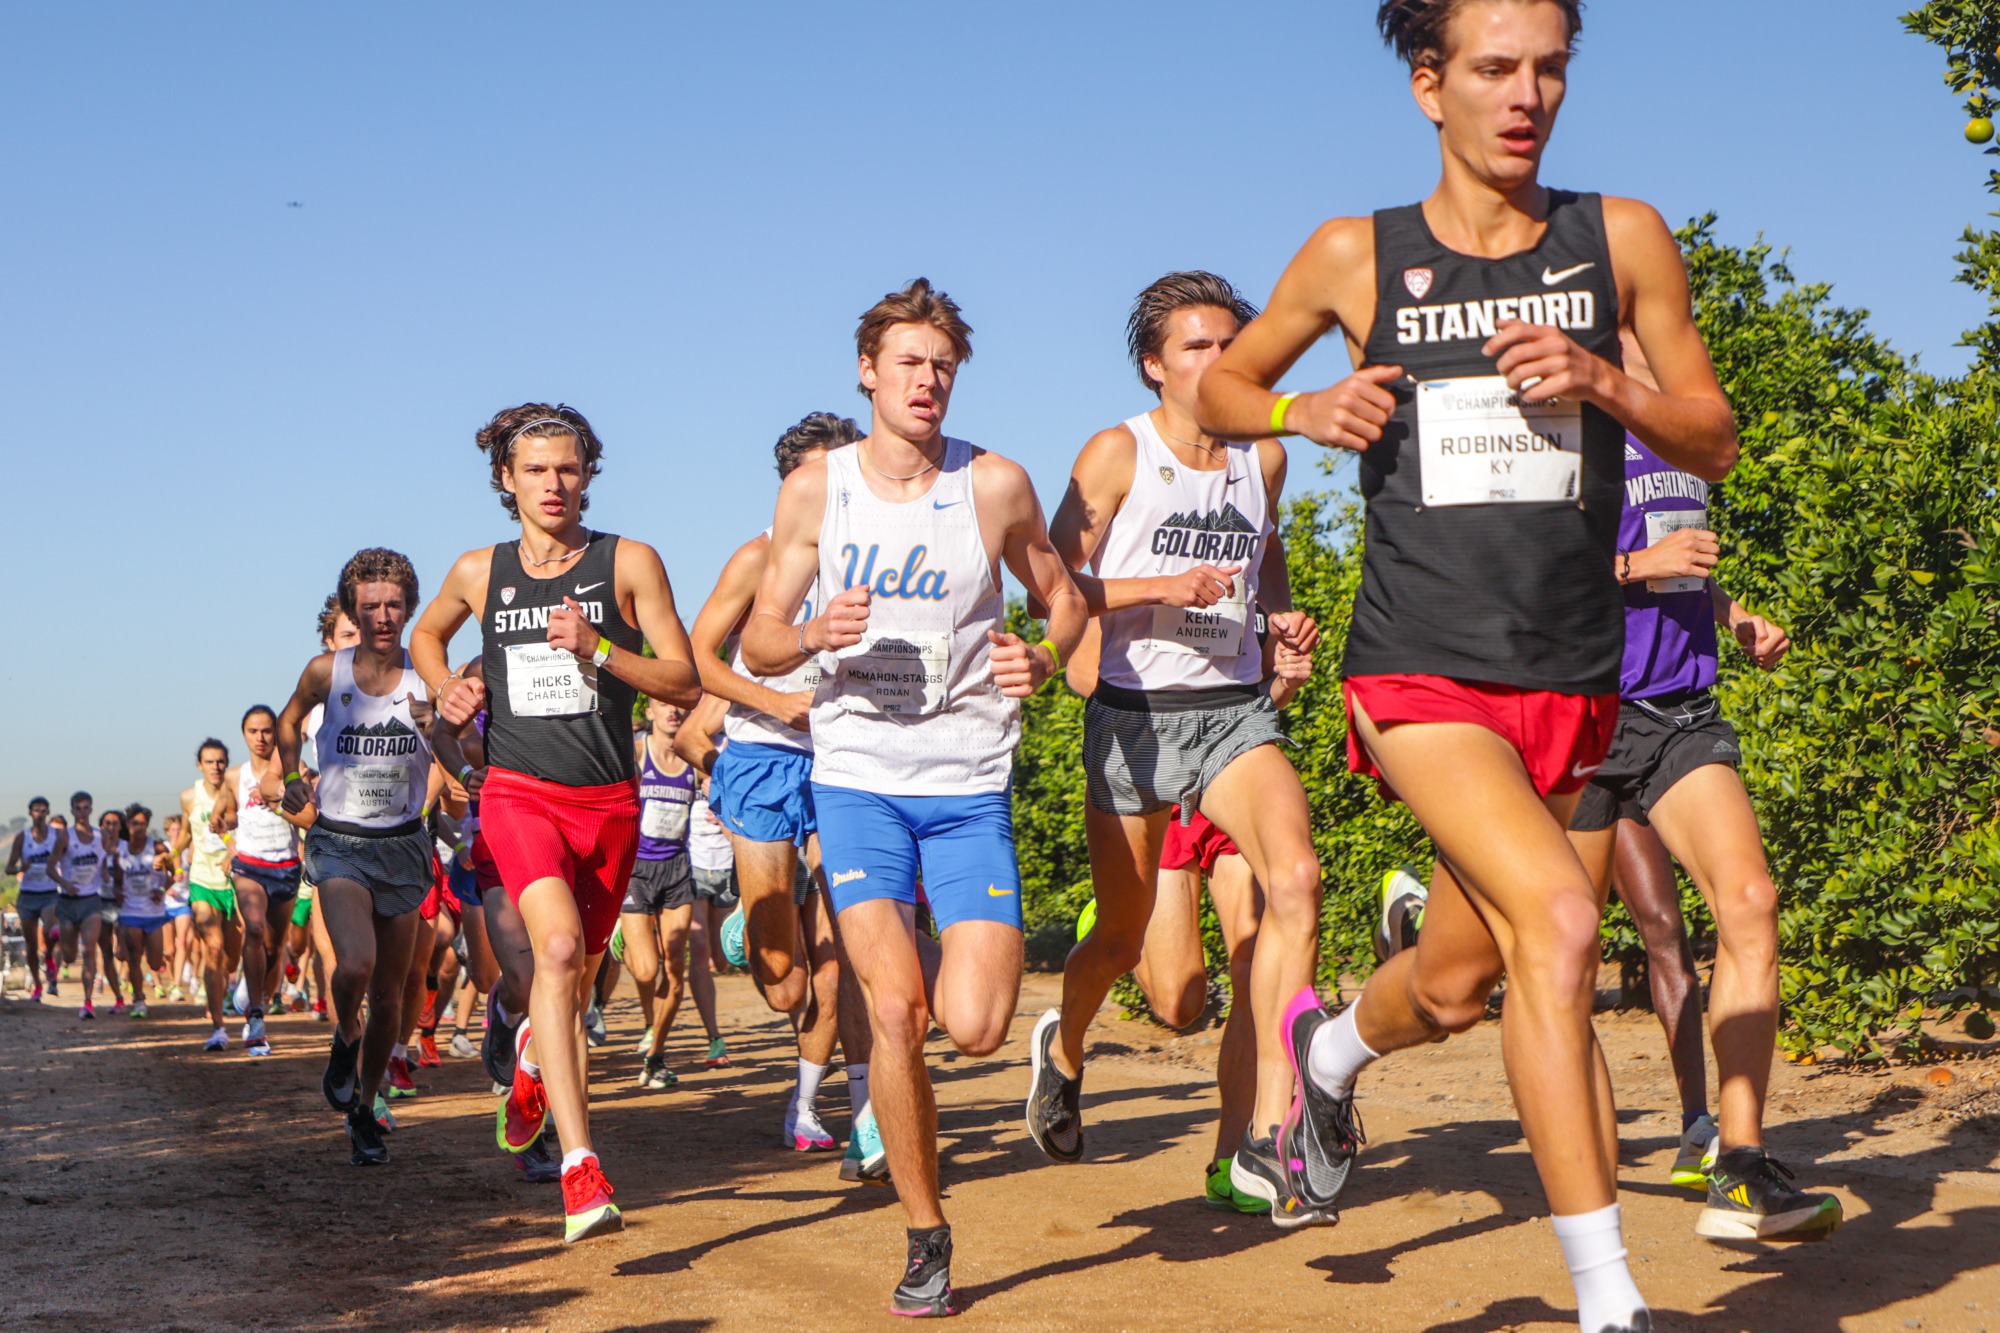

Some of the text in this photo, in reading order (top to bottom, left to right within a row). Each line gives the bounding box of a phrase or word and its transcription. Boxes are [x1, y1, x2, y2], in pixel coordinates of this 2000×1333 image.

[1396, 291, 1594, 345] STANFORD
[1441, 433, 1562, 455] ROBINSON
[1491, 460, 1514, 475] KY
[1626, 471, 1708, 508] WASHINGTO
[1151, 528, 1260, 561] COLORADO
[495, 602, 603, 633] STAND
[1185, 612, 1222, 625] KENT
[1176, 626, 1228, 639] ANDREW
[526, 653, 575, 663] CHAMPIONSHI
[533, 675, 571, 688] HICKS
[848, 670, 943, 684] MCMAHON-STAGGS
[527, 689, 579, 701] CHARLES
[876, 688, 910, 697] RONAN
[336, 736, 417, 756] COLORADO
[359, 789, 393, 797] VANCIL
